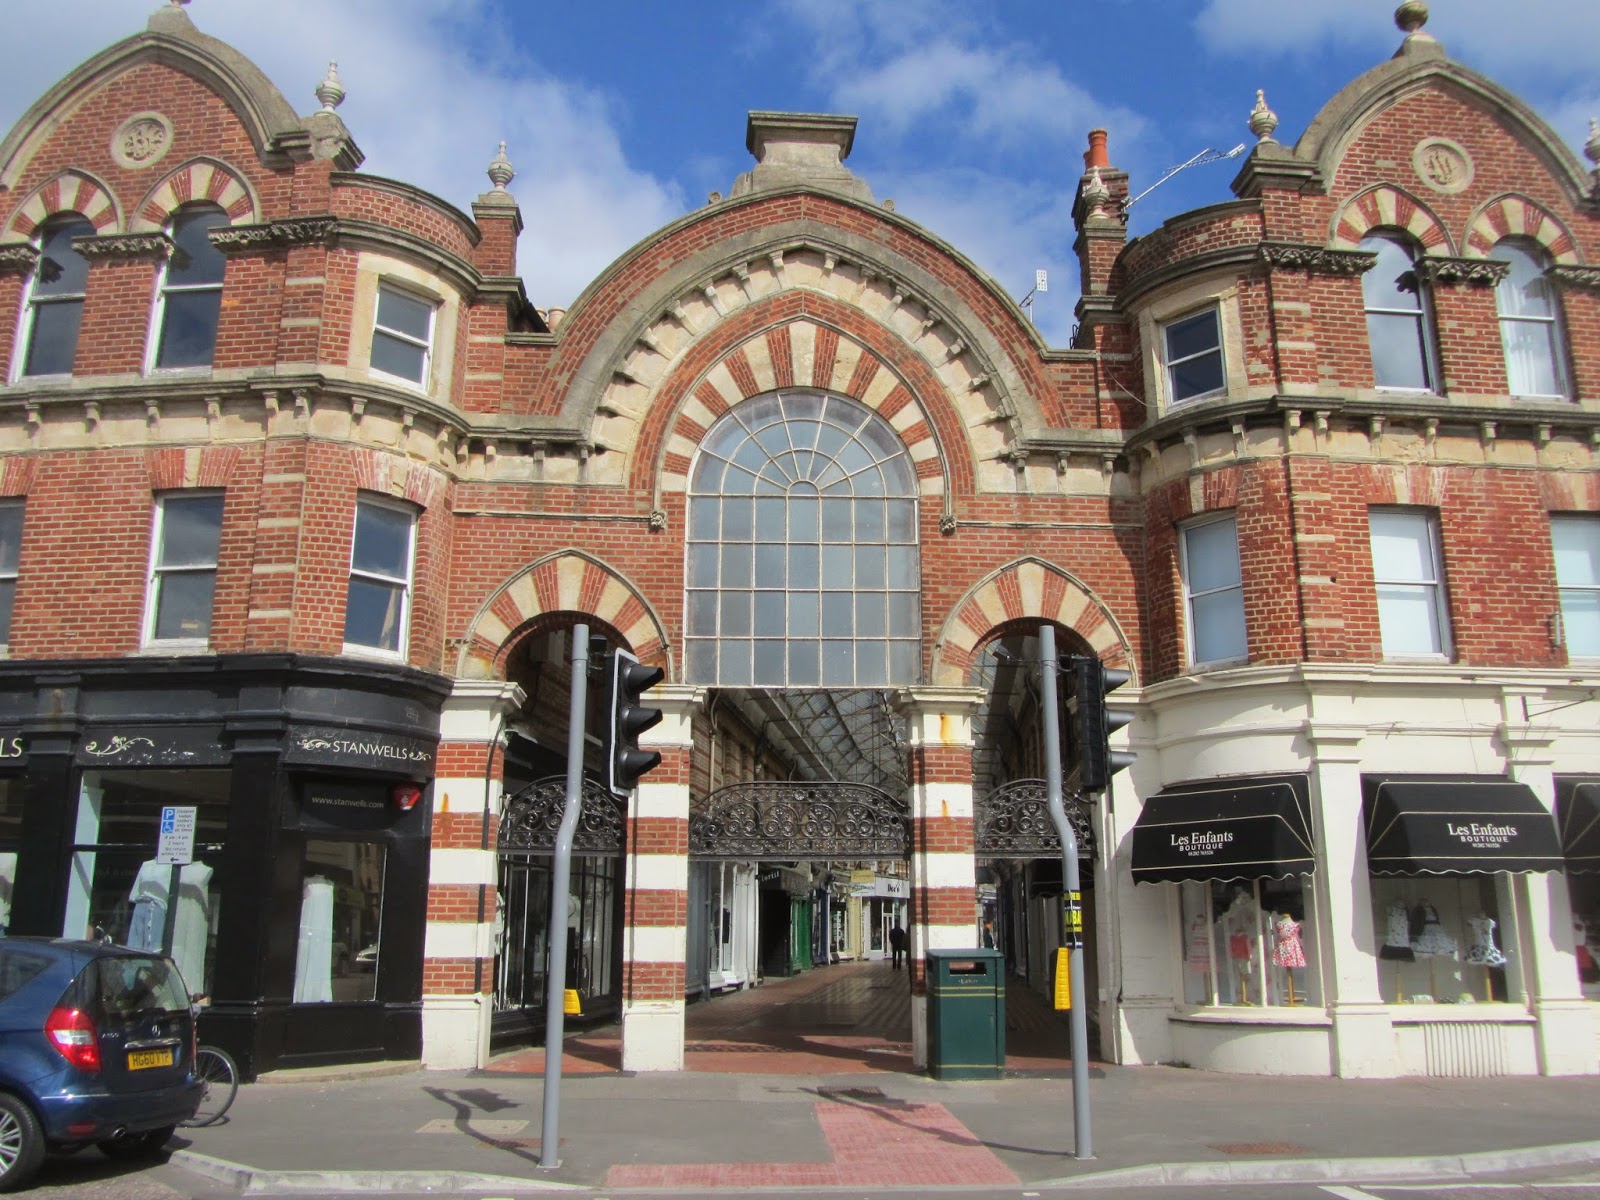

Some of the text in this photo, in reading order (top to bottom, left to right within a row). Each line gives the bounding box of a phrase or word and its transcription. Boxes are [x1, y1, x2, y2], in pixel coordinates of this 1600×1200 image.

[333, 740, 408, 760] STANWELLS
[311, 796, 384, 809] www.stanwells.com
[1447, 823, 1518, 836] Les Enfants
[1170, 831, 1233, 846] Les Enfants
[1179, 843, 1223, 852] BOUTIQUE
[132, 1052, 155, 1067] HG60
